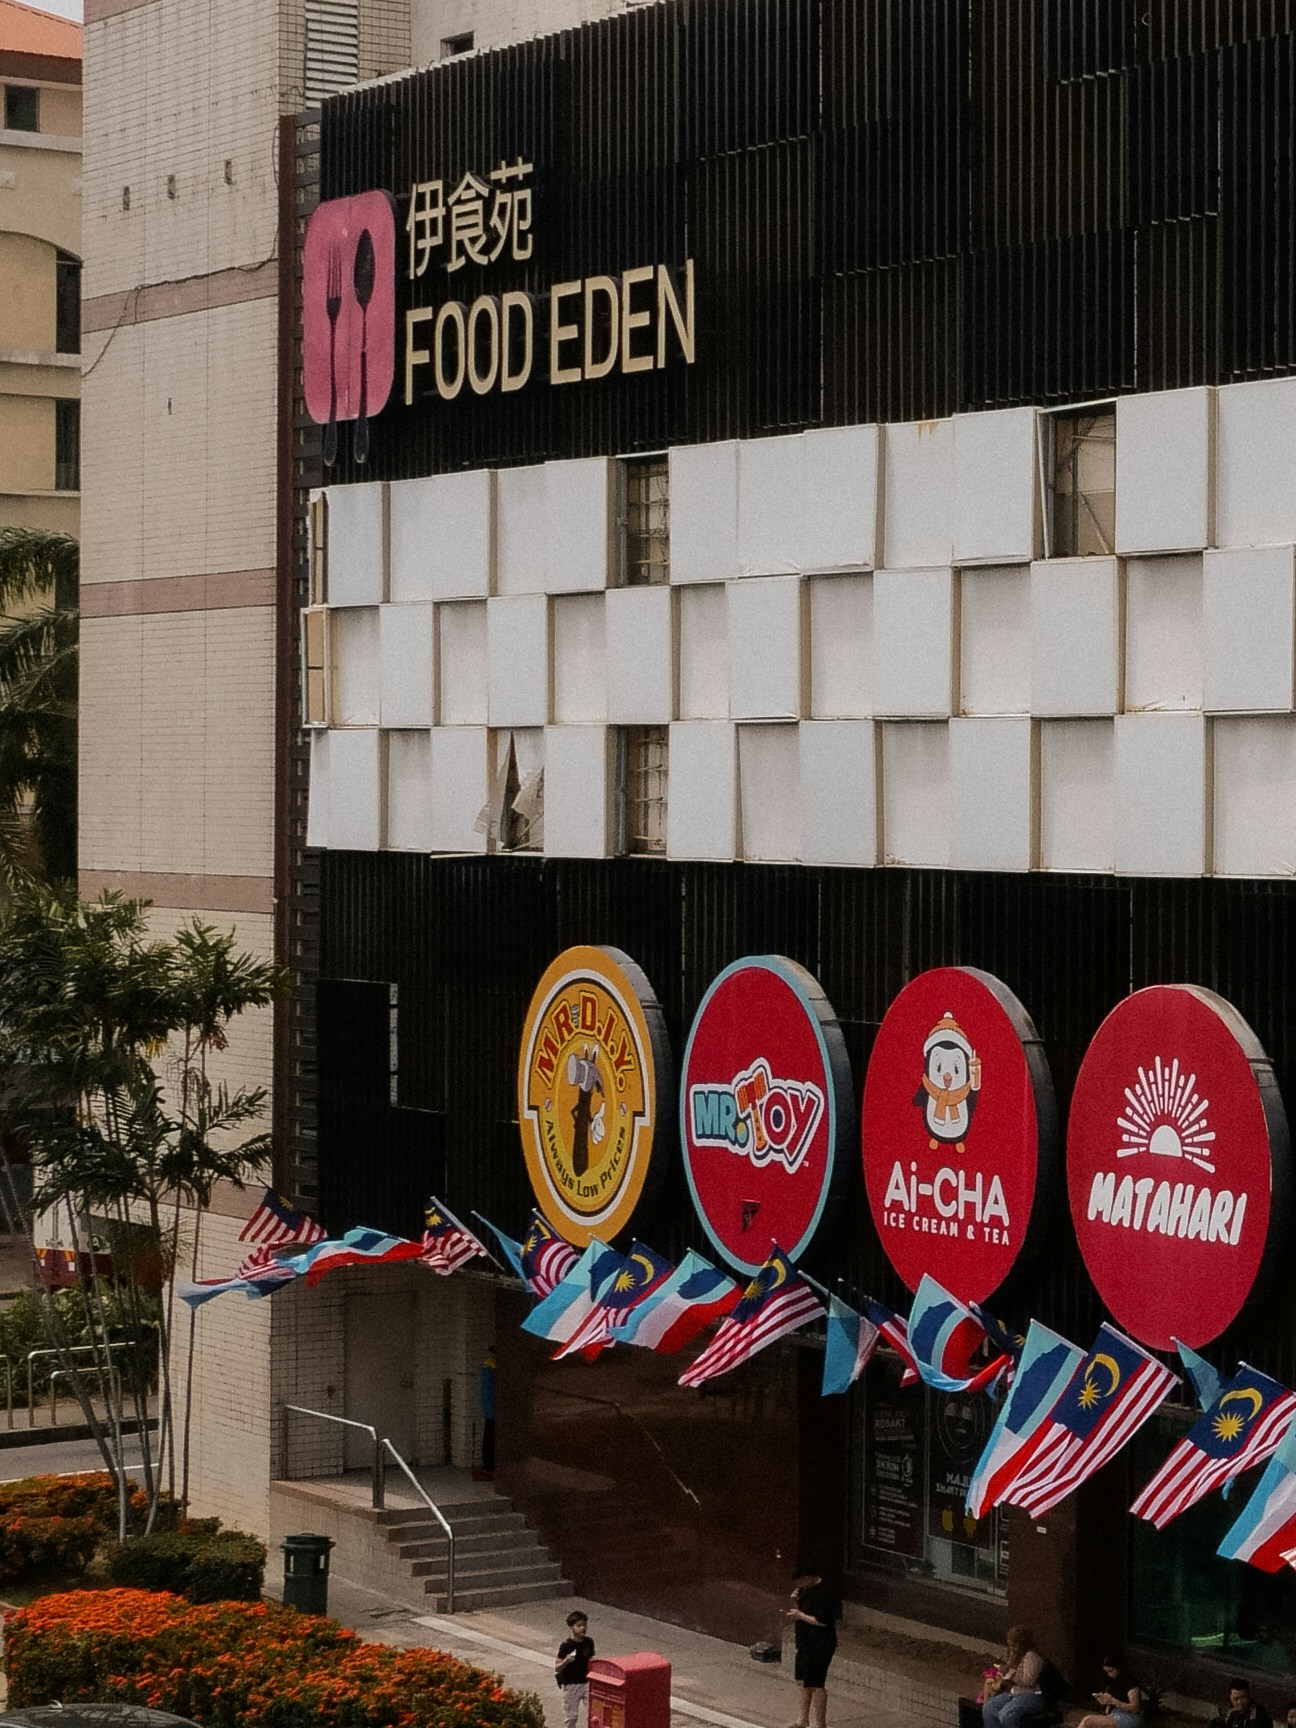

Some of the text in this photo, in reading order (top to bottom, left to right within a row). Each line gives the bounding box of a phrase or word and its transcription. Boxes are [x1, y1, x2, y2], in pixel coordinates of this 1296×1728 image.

[406, 156, 534, 280] 伊食苑
[405, 259, 695, 405] FOOD EDEN
[545, 1119, 627, 1198] Always Low Prices
[884, 1161, 1010, 1227] Ai-CHA
[884, 1211, 1010, 1246] ICE CREAM & TEA
[1087, 1172, 1247, 1246] MATAHARI
